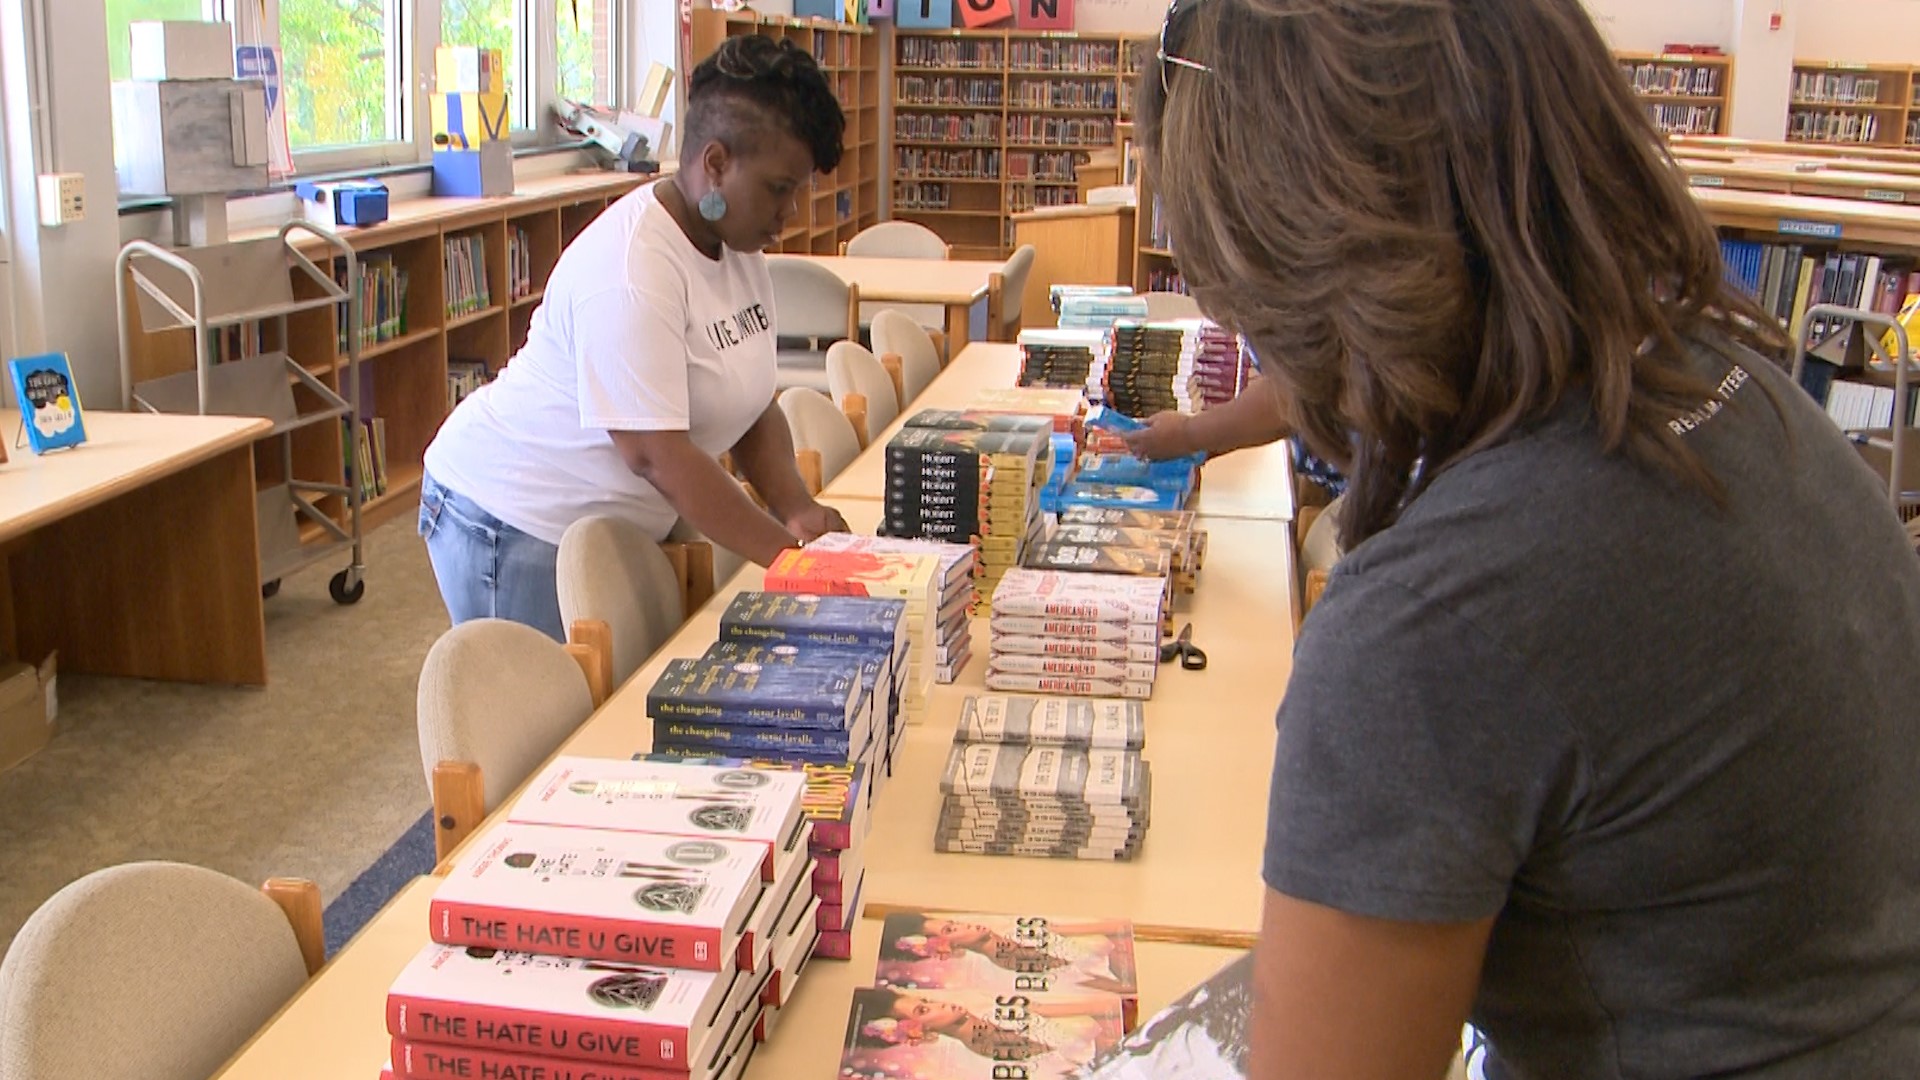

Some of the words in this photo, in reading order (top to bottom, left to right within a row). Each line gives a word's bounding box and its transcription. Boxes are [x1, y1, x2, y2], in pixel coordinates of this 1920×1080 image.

[1045, 604, 1098, 616] AMERICANIZED
[744, 628, 785, 639] changeling
[1044, 622, 1097, 635] AMERICANIZED
[1044, 644, 1097, 657] AMERICANIZED
[1042, 661, 1096, 675] AMERICANIZED
[1038, 680, 1091, 692] AMERICANIZED
[676, 704, 722, 719] changeling
[685, 727, 731, 740] changeling
[461, 917, 507, 941] THE
[516, 923, 580, 949] HATE
[589, 933, 605, 951] U
[614, 934, 675, 958] GIVE
[419, 1012, 467, 1032] THE
[476, 1019, 542, 1046] HATE
[551, 1030, 567, 1048] U
[578, 1032, 640, 1056] GIVE
[992, 995, 1030, 1080] BELLES
[424, 1053, 471, 1078] THE
[481, 1060, 546, 1080] HATE
